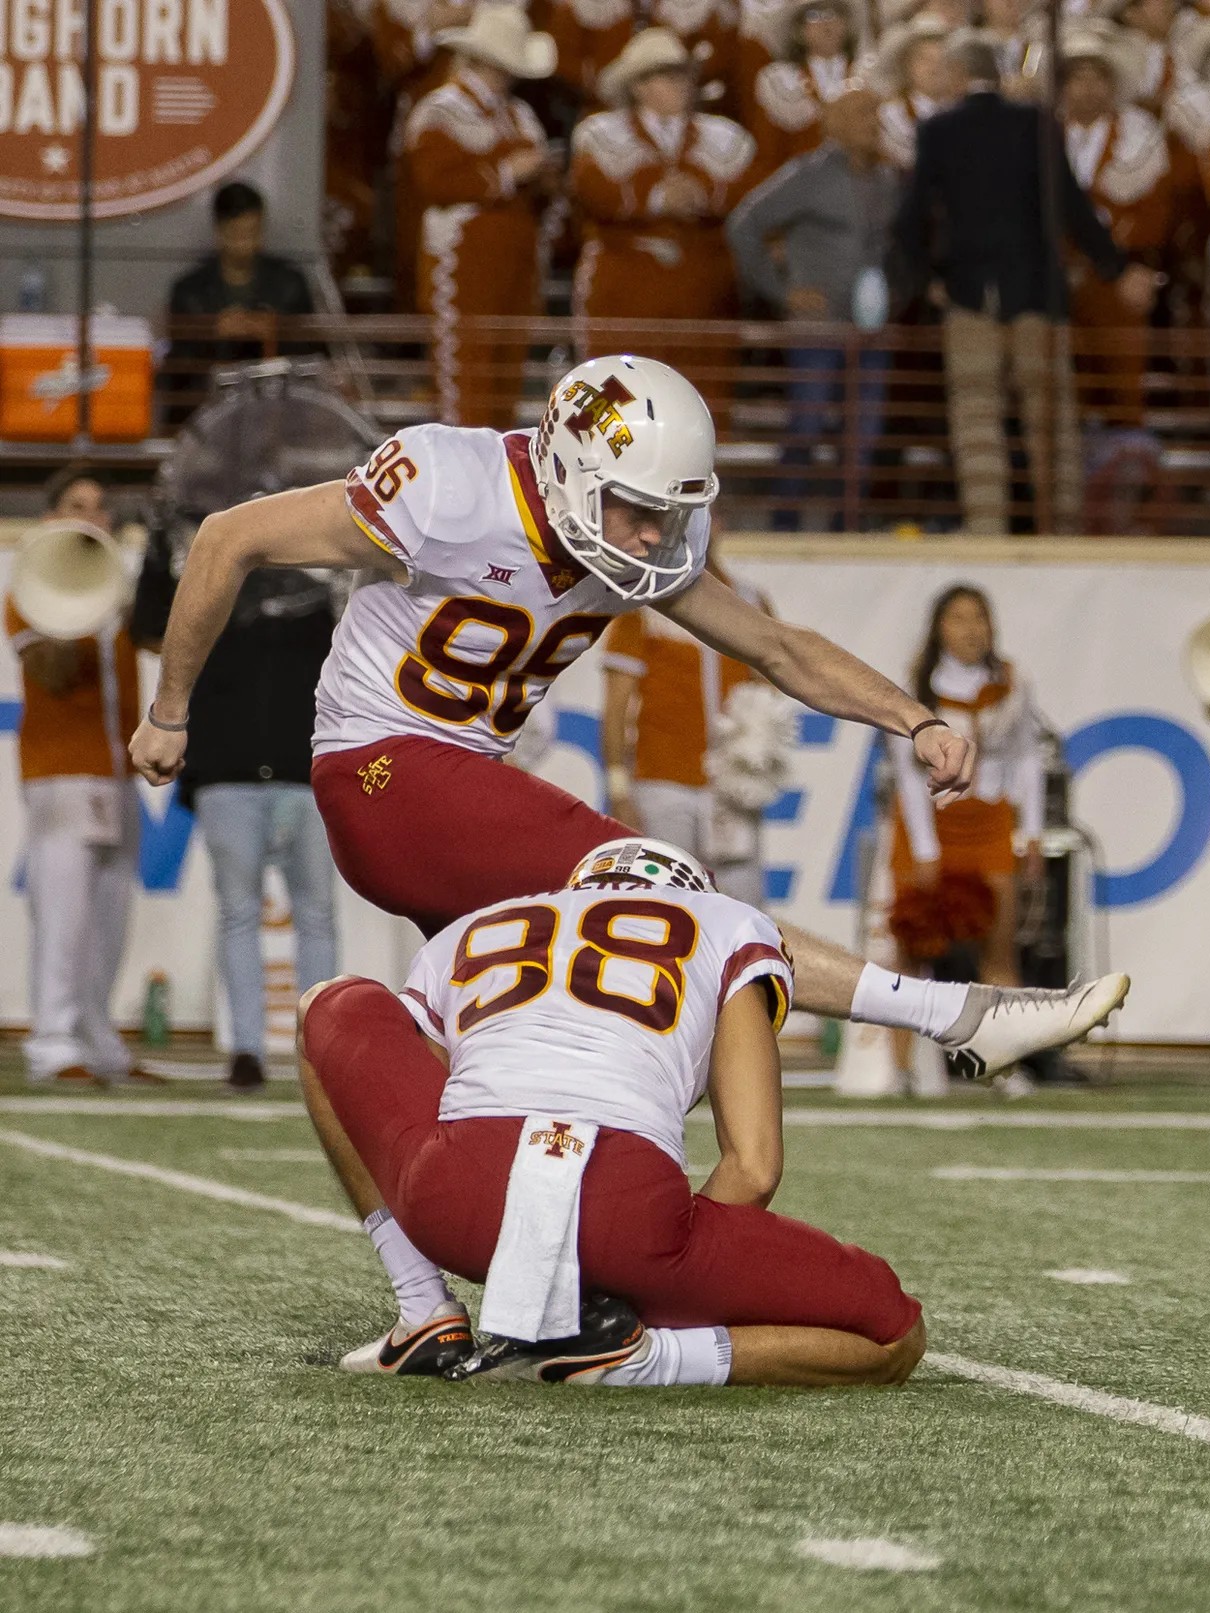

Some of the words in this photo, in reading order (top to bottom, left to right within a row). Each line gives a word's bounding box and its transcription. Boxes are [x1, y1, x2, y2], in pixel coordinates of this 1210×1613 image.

[0, 0, 229, 65] GHORN
[560, 379, 634, 460] STATE
[364, 438, 420, 504] 96
[448, 897, 700, 1036] 98
[528, 1130, 585, 1157] STATE
